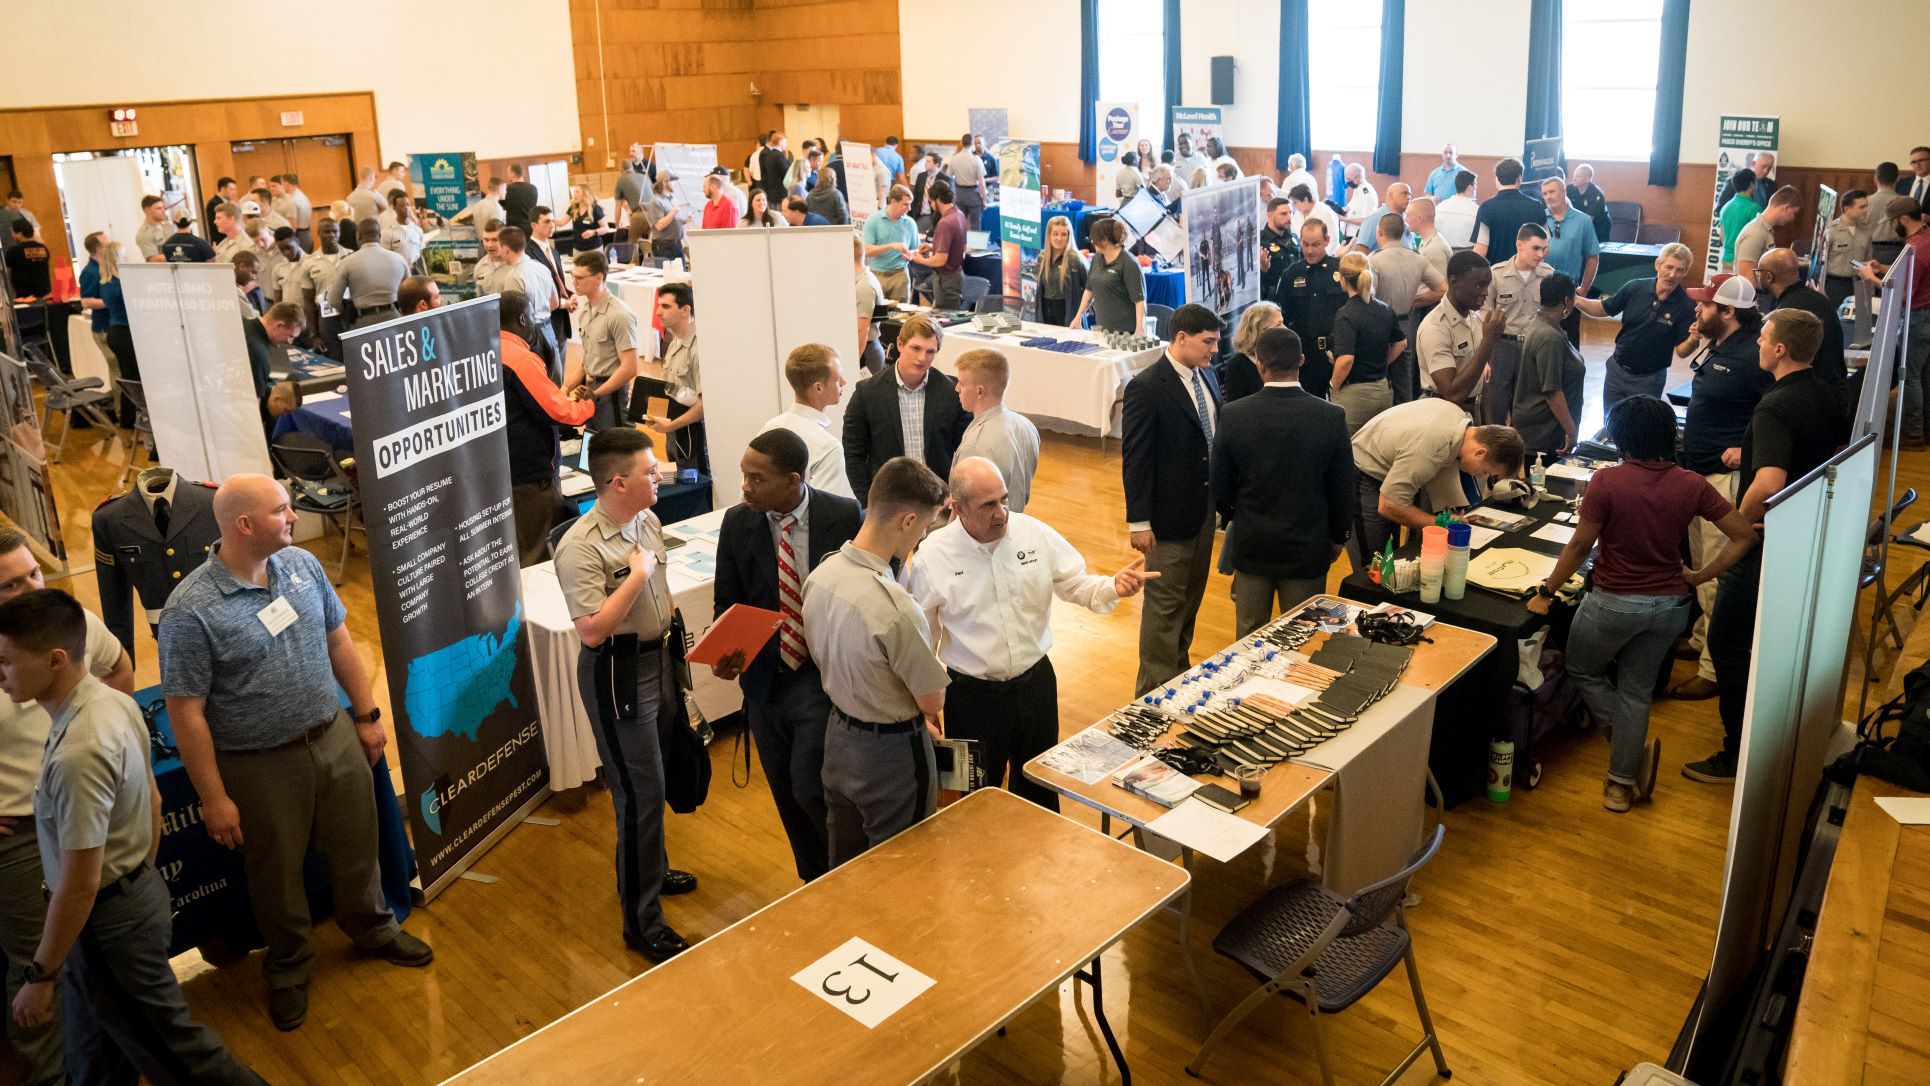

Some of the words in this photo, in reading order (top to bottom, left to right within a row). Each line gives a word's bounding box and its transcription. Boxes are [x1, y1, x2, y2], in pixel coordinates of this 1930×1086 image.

[1199, 112, 1217, 120] Health
[1722, 119, 1737, 131] JOIN
[1737, 120, 1751, 132] OUR
[1756, 140, 1772, 148] OFFICE
[430, 186, 461, 196] EVERYTHING
[437, 194, 456, 203] UNDER
[436, 202, 446, 211] THE
[361, 330, 418, 381] SALES
[421, 326, 437, 362] &
[403, 349, 498, 413] MARKETING
[379, 401, 502, 469] OPPORTUNITIES
[388, 495, 410, 512] BOOST
[409, 487, 426, 501] YOUR
[426, 476, 453, 494] RESUME
[388, 509, 406, 524] WITH
[406, 495, 440, 517] HANDS-ON,
[458, 513, 482, 531] HOUSING
[481, 502, 502, 517] SET-UP
[502, 496, 511, 508] FOR
[390, 512, 429, 537] REAL-WORLD
[392, 525, 428, 550] EXPERIENCE
[459, 533, 471, 543] ALL
[470, 519, 493, 537] SUMMER
[492, 508, 513, 523] INTERNS
[396, 557, 418, 574] SMALL
[417, 542, 447, 562] COMPANY
[463, 554, 475, 566] ASK
[474, 544, 492, 559] ABOUT
[491, 537, 503, 548] THE
[463, 556, 491, 578] POTENTIAL
[491, 550, 499, 560] TO
[499, 543, 514, 556] EARN
[397, 567, 424, 587] CULTURE
[424, 555, 446, 571] PAIRED
[465, 570, 488, 589] COLLEGE
[487, 560, 508, 575] CREDIT
[507, 554, 515, 565] AS
[398, 585, 416, 599] WITH
[416, 573, 434, 590] LARGE
[401, 589, 429, 611] COMPANY
[466, 590, 475, 600] AN
[475, 578, 493, 596] INTERN
[402, 602, 428, 624] GROWTH
[429, 720, 539, 815] CLEARDEFENSE
[430, 769, 542, 867] WWW.CLEARDEFENSEPEST.COM
[822, 953, 900, 1005] 13
